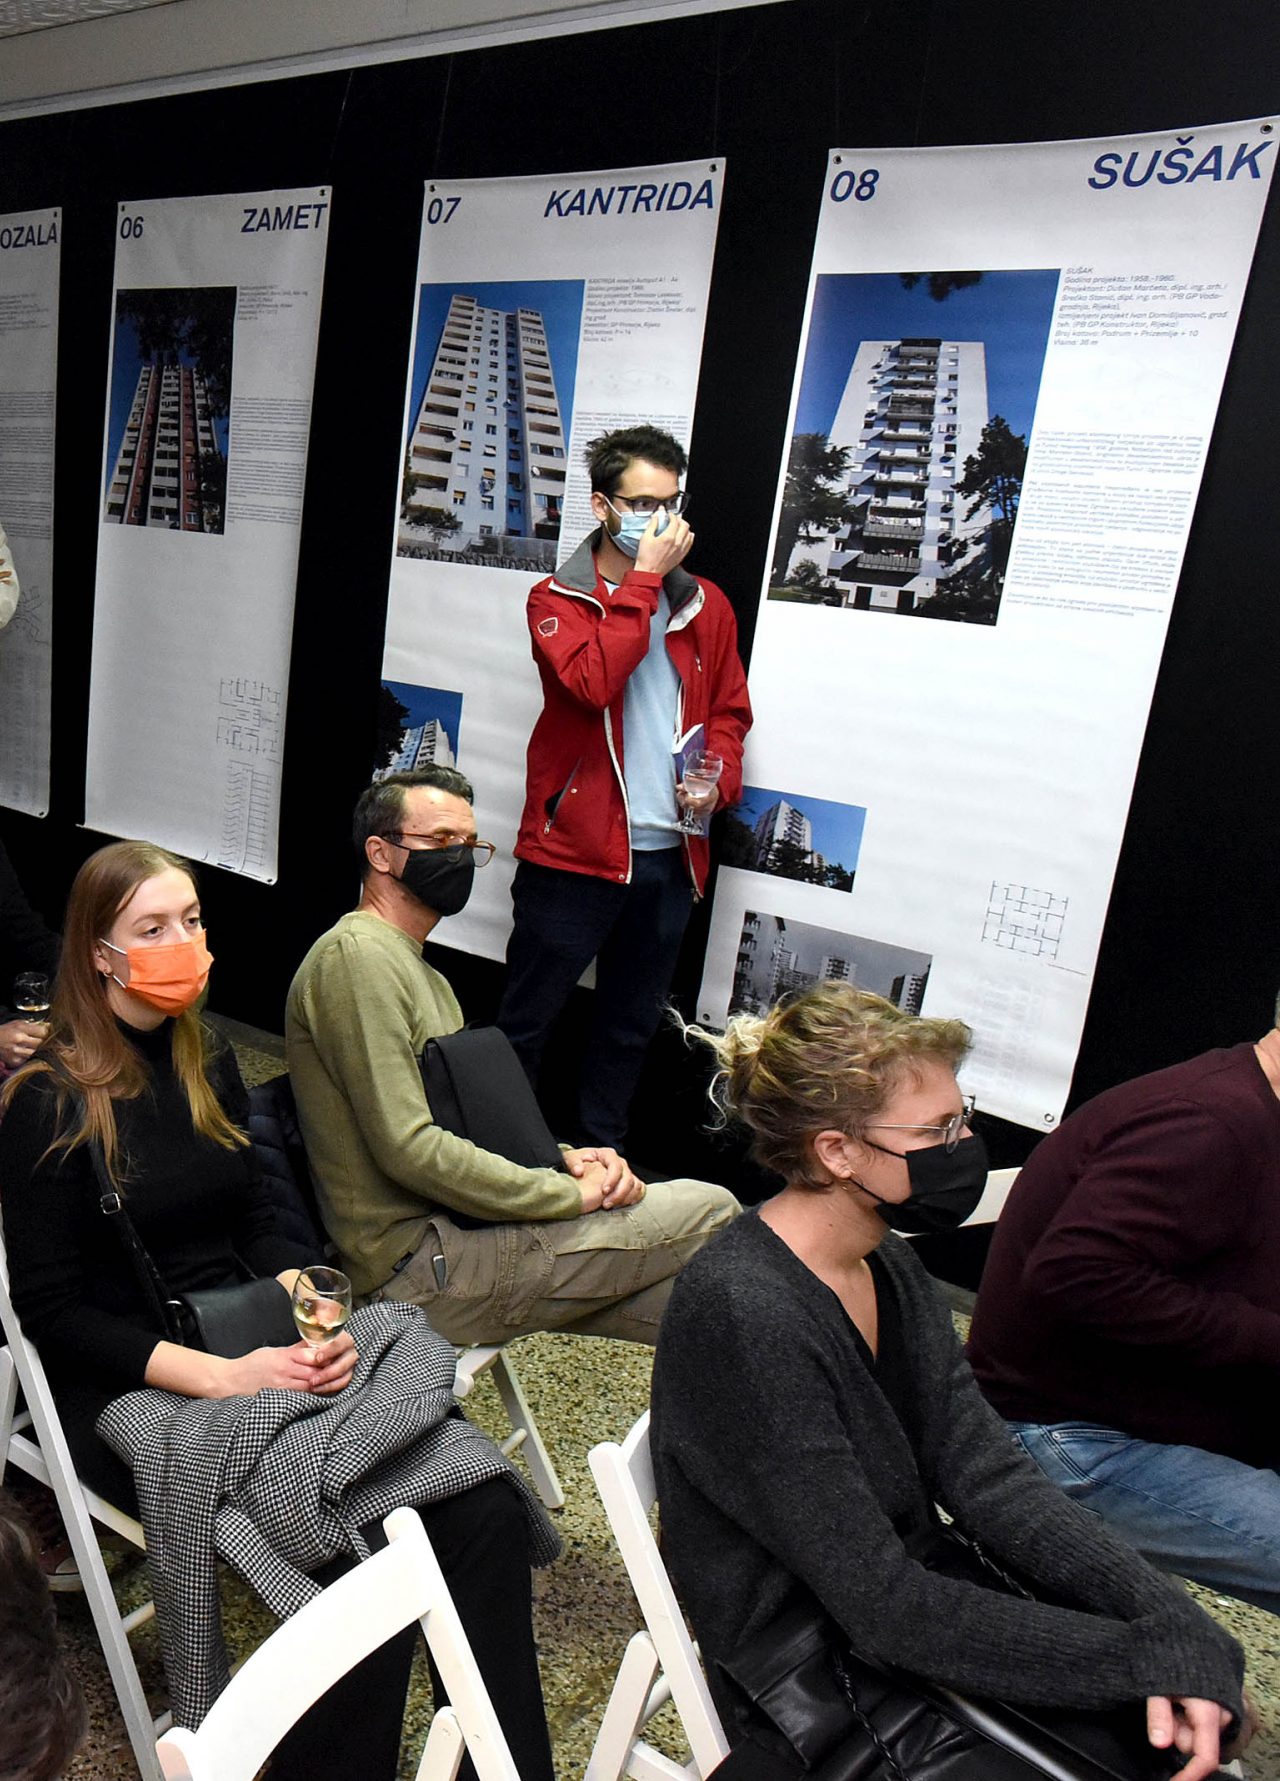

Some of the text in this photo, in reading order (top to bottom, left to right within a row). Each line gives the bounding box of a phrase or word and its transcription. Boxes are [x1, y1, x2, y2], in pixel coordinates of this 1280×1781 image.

[1087, 135, 1275, 190] SUŠAK
[543, 179, 714, 218] KANTRIDA
[830, 168, 880, 202] 08
[120, 215, 144, 239] 06
[240, 203, 328, 233] ZAMET
[427, 197, 462, 225] 07
